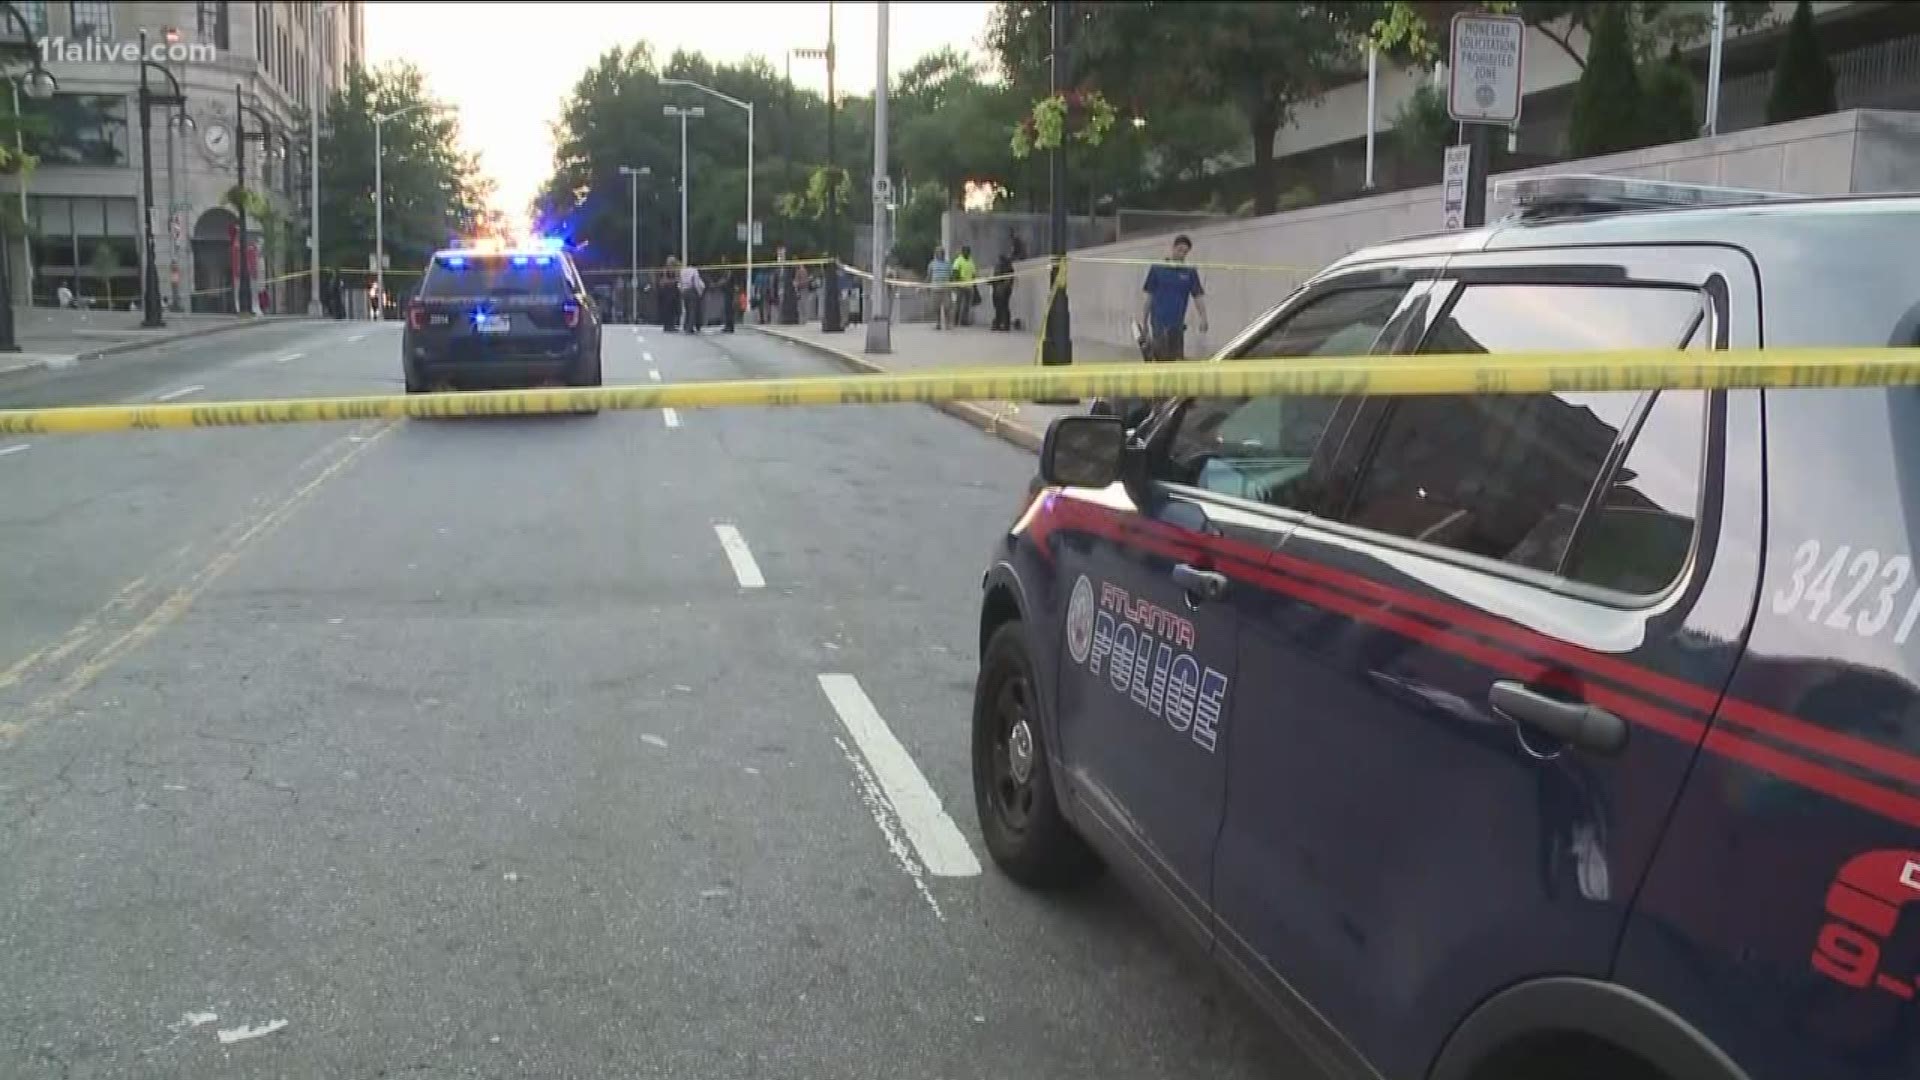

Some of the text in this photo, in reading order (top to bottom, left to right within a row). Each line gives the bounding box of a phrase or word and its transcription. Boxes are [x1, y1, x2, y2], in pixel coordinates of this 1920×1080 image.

[1474, 66, 1497, 80] ZONE
[1100, 581, 1195, 650] ATLANTA
[1089, 610, 1228, 753] POLICE
